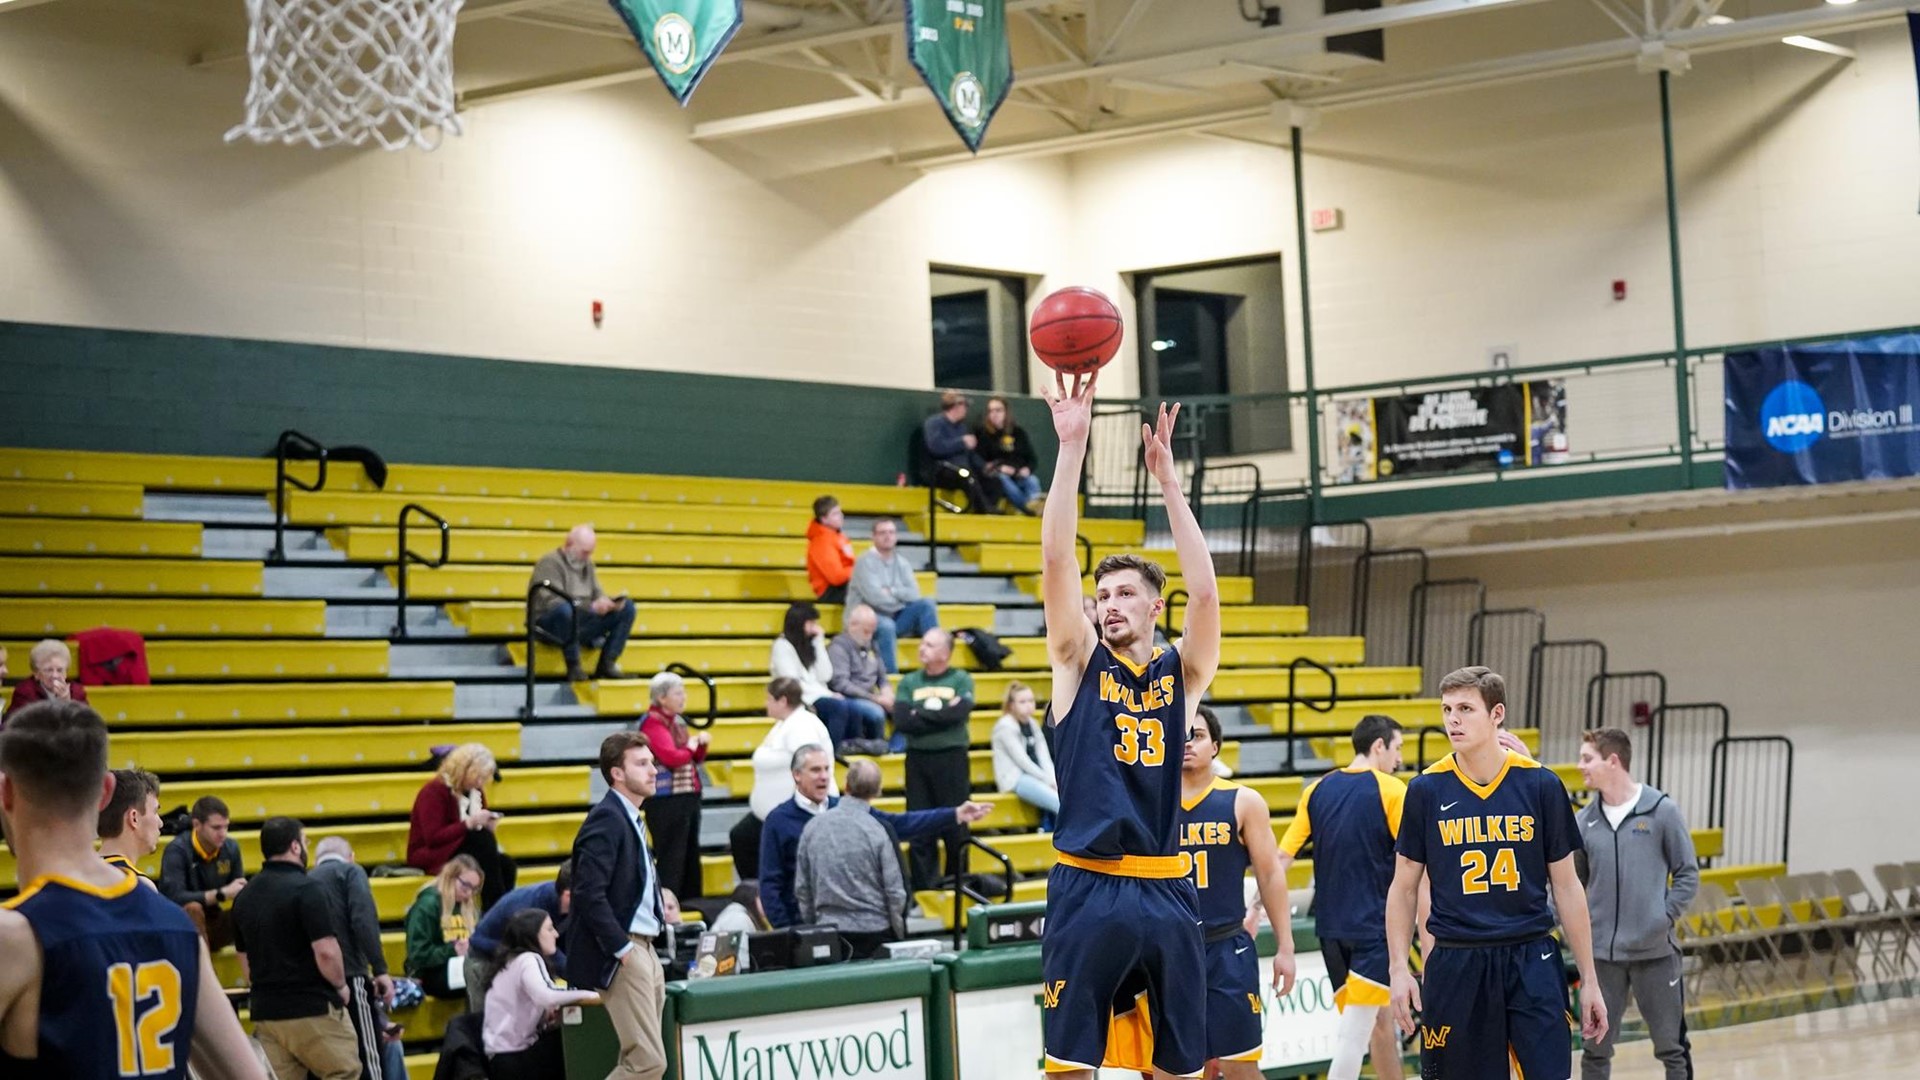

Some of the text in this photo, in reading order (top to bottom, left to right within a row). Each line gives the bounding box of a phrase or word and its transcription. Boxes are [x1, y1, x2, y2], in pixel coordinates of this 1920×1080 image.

[666, 31, 684, 54] M
[1767, 404, 1913, 437] NCAA Division III
[1100, 671, 1175, 712] WILKES
[1114, 713, 1166, 767] 33
[1179, 822, 1232, 846] LKES
[1438, 815, 1535, 846] WILKES
[1460, 848, 1520, 894] 24
[107, 960, 182, 1077] 12
[693, 1008, 913, 1080] Marywood
[1421, 1025, 1451, 1050] W
